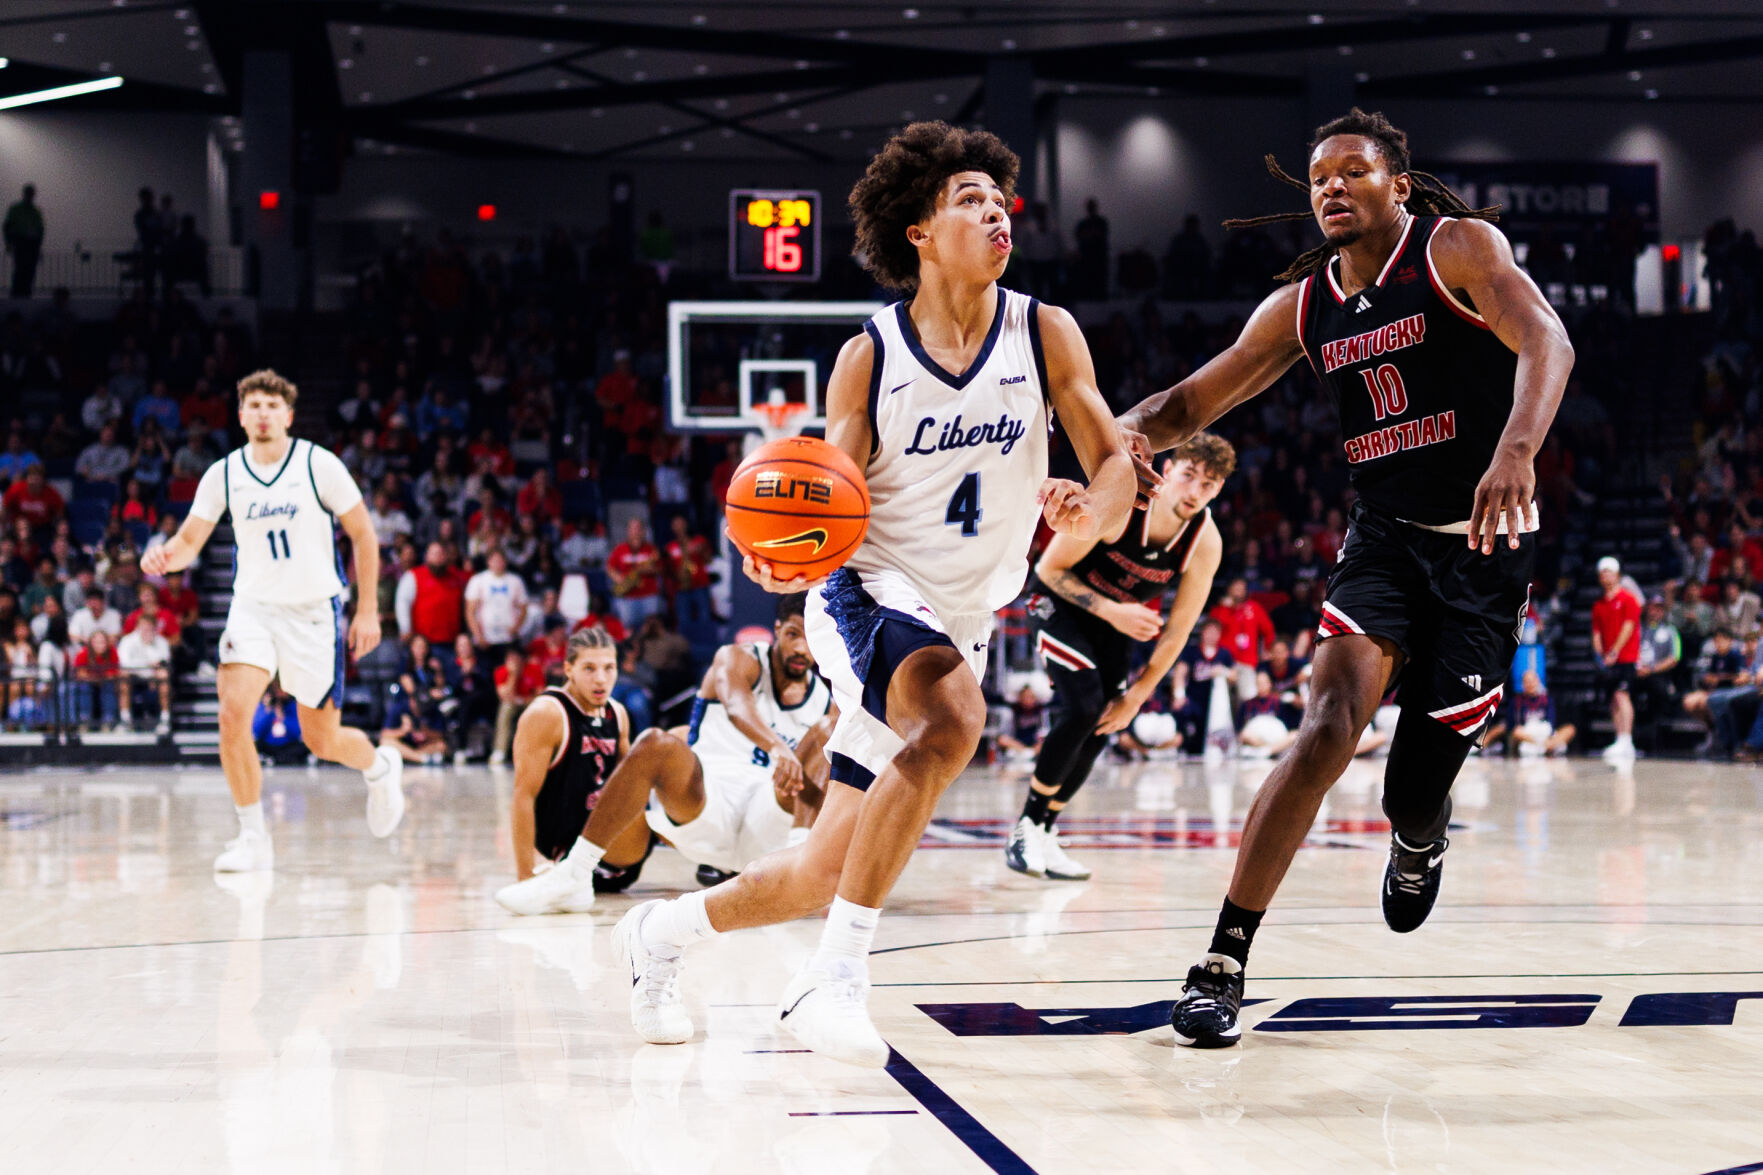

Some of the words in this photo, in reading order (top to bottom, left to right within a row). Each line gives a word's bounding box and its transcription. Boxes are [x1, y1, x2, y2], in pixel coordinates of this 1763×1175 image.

[1487, 184, 1609, 214] STORE
[763, 226, 802, 272] 16
[1321, 313, 1426, 374] KENTUCKY
[1000, 375, 1027, 386] C-USA
[1358, 363, 1409, 422] 10
[904, 414, 1026, 456] Liberty
[1344, 410, 1456, 464] CHRISTIAN
[245, 501, 299, 521] Liberty
[944, 471, 984, 538] 4
[266, 528, 291, 560] 11
